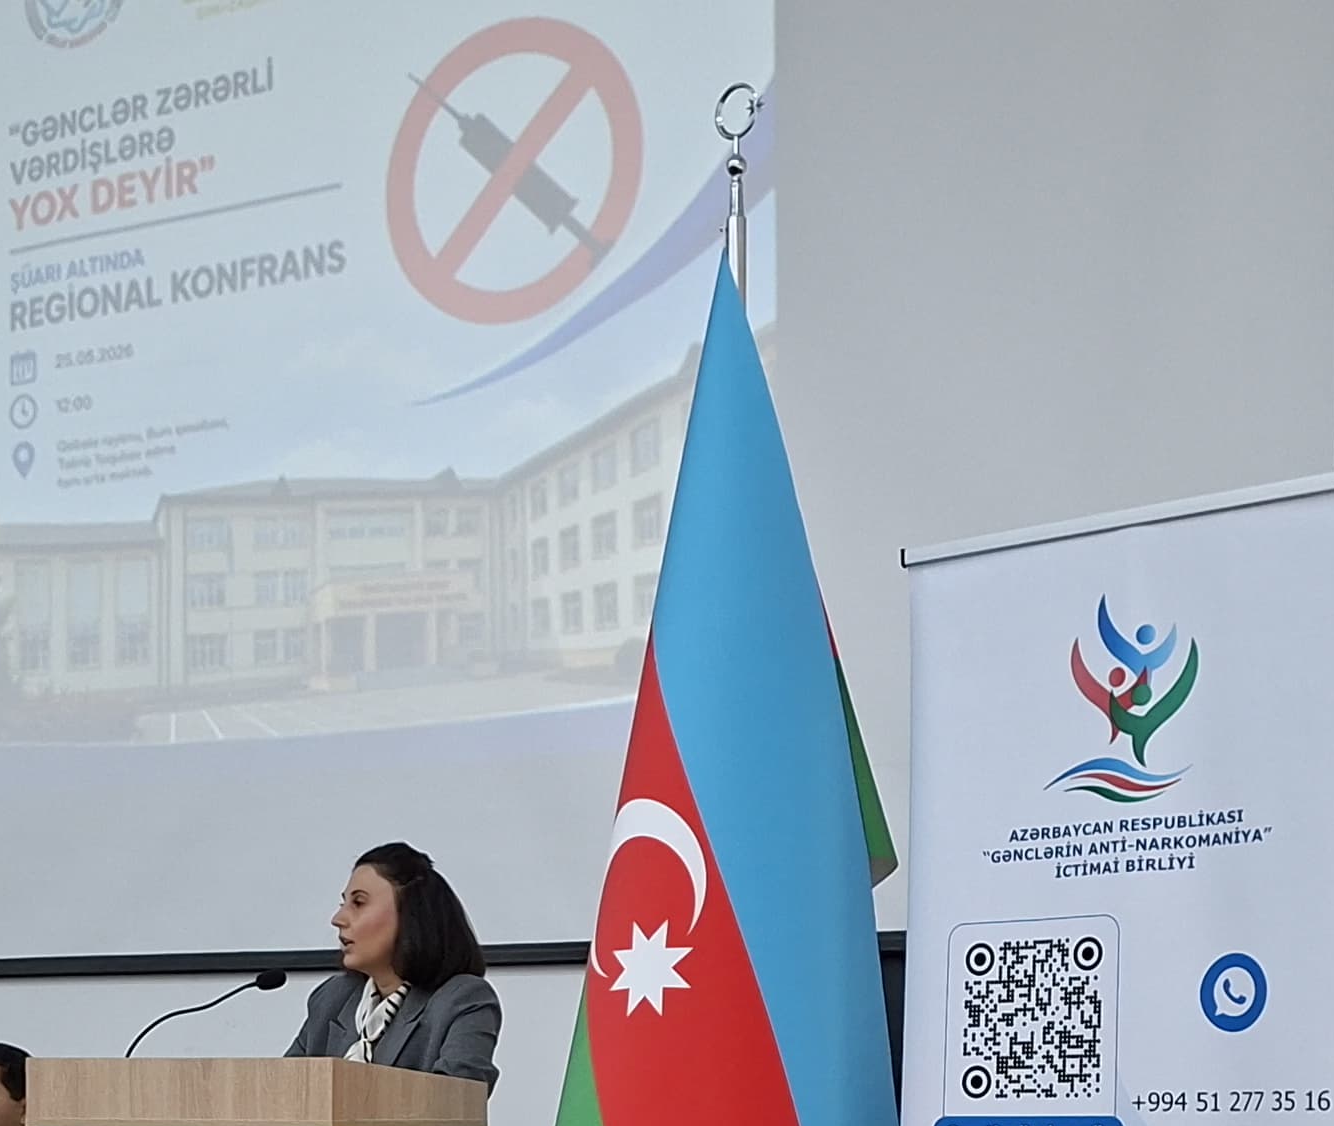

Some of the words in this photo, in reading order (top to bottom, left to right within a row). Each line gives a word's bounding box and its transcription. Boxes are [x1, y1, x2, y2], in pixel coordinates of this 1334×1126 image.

[8, 93, 148, 147] “GƏNCLƏR
[156, 56, 273, 116] ZƏRƏRLİ
[9, 125, 175, 186] VƏRDİŞLƏRƏ
[8, 183, 79, 232] YOX
[90, 154, 215, 215] DEYİR”
[9, 276, 162, 332] REGİONAL
[170, 239, 346, 304] KONFRANS
[10, 263, 62, 293] ŞÜARI
[65, 247, 145, 280] ALTINDA
[982, 841, 1084, 864] “GƏNCLƏRİN
[1088, 826, 1273, 856] ANTİ-NARKOMANİYA”
[1009, 820, 1113, 843] AZƏRBAYCAN
[1119, 809, 1244, 833] RESPUBLİKASI
[1055, 856, 1119, 878] İCTİMAİ
[1125, 852, 1195, 872] BİRLİYİ
[1131, 1091, 1187, 1112] +994
[1196, 1091, 1220, 1112] 51
[1229, 1090, 1264, 1112] 277
[1271, 1090, 1296, 1111] 35
[1306, 1090, 1331, 1111] 16
